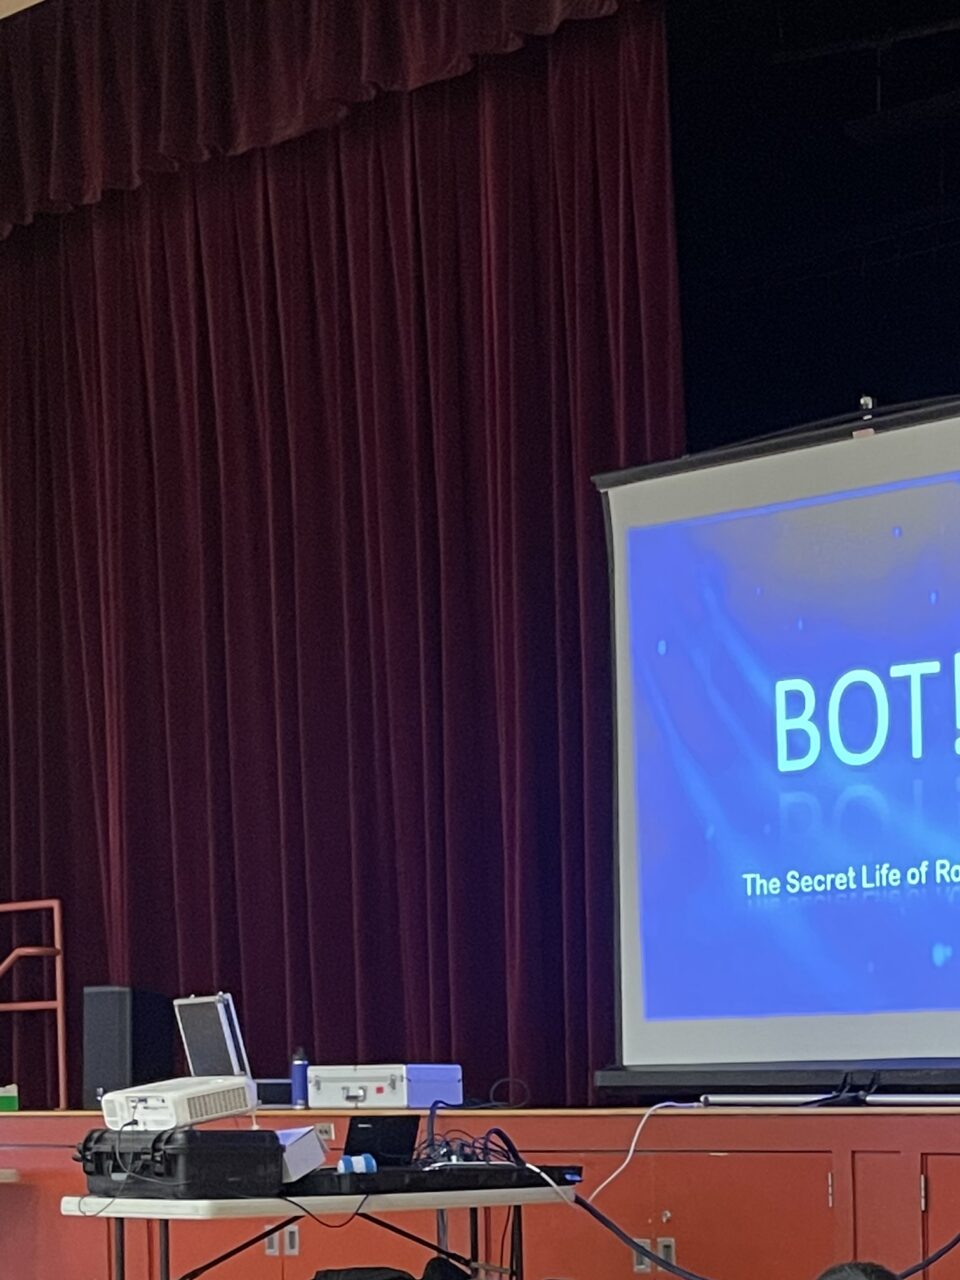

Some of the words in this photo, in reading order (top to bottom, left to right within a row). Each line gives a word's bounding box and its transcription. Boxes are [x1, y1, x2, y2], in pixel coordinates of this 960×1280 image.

[742, 873, 781, 896] The
[786, 866, 857, 893] Secret
[861, 863, 901, 888] Life
[906, 860, 929, 885] of
